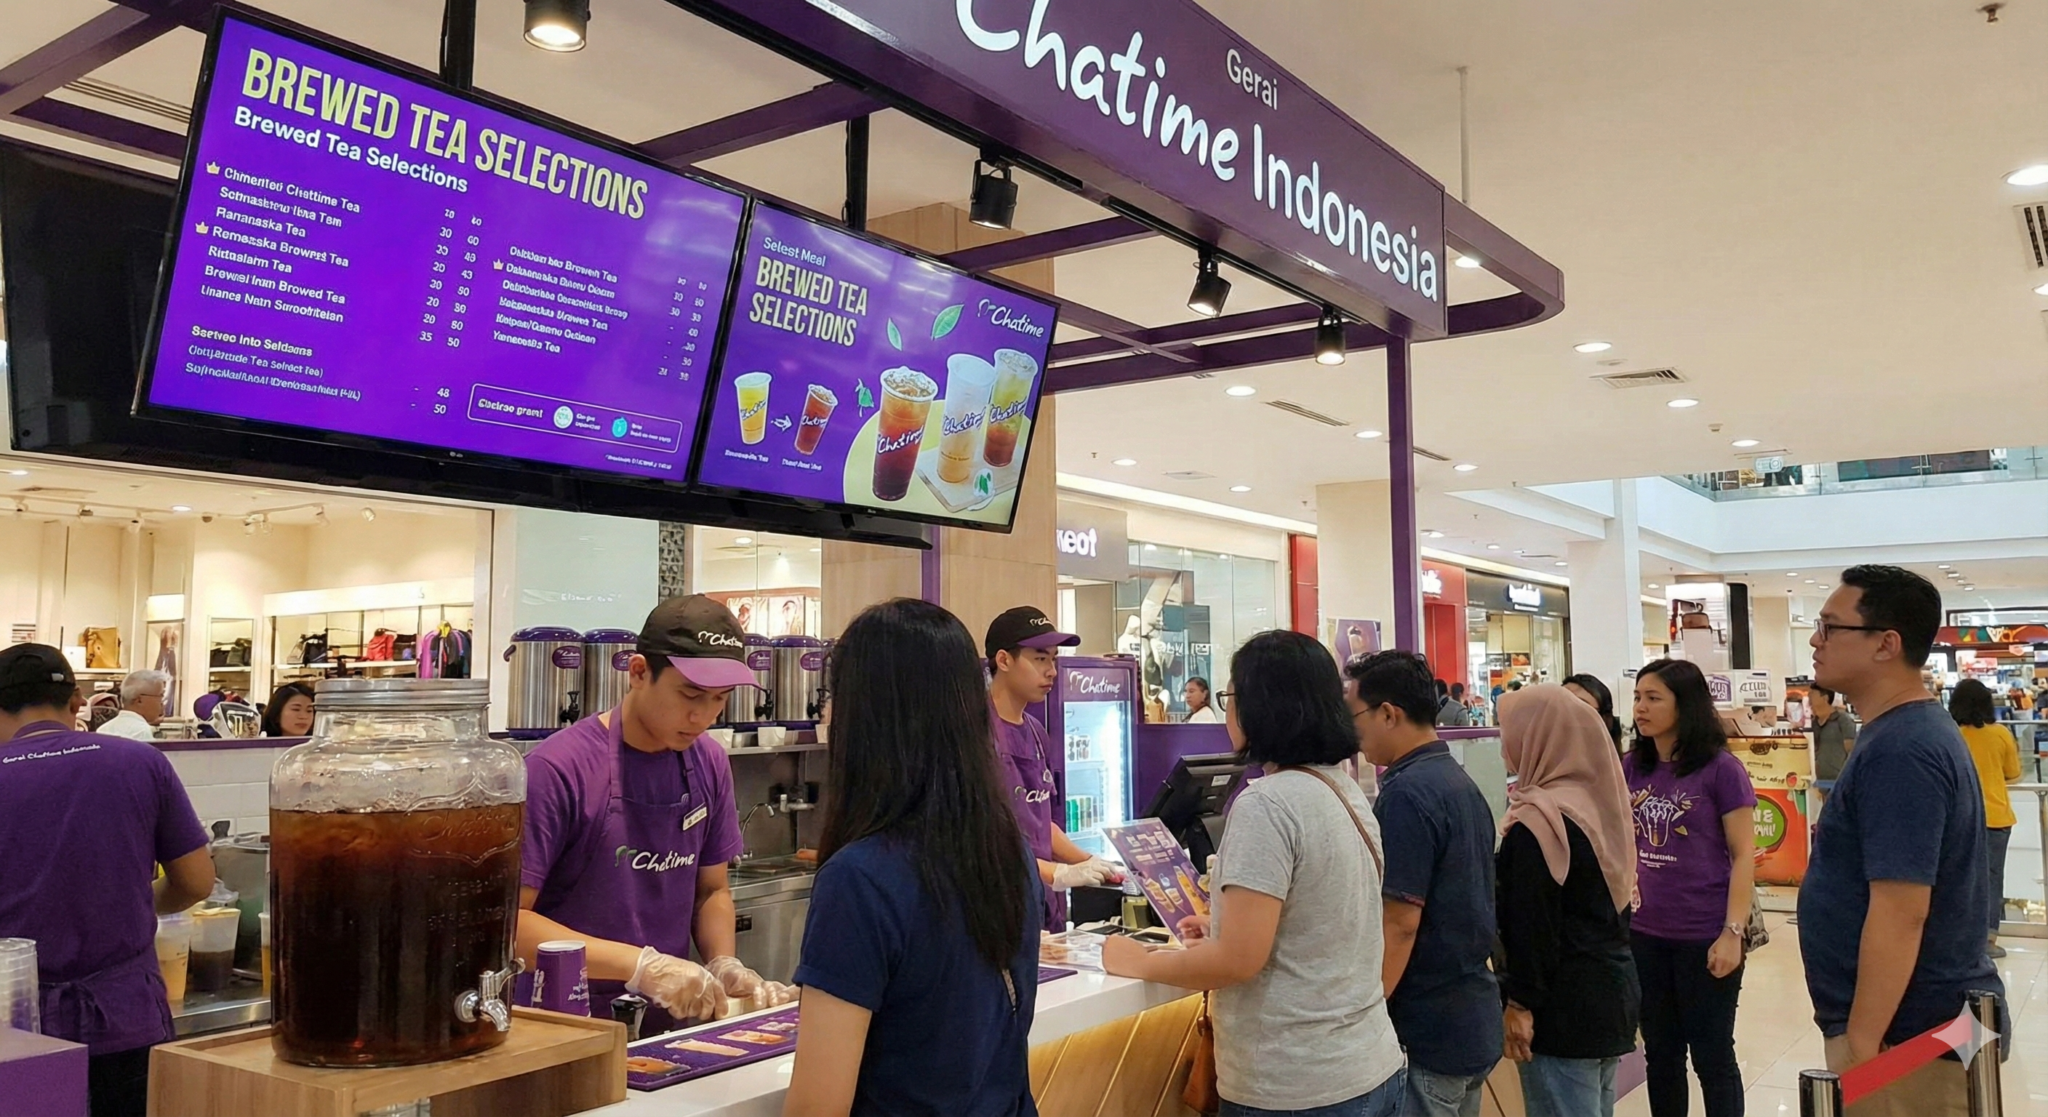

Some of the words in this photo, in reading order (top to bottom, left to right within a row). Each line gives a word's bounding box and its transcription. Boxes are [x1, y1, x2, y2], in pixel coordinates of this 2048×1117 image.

[1226, 47, 1279, 111] Gerai
[242, 48, 400, 140] BREWED
[409, 103, 467, 164] TEA
[474, 128, 649, 219] SELECTIONS
[234, 105, 321, 149] Brewed
[326, 133, 361, 161] Tea
[366, 147, 469, 193] Selections
[955, 0, 1240, 181] Chatime
[1253, 123, 1438, 302] Indonesia
[341, 197, 360, 214] Tea
[286, 223, 306, 238] Tea
[439, 227, 452, 239] 30
[329, 253, 350, 267] Tea
[801, 248, 827, 267] Meal
[271, 259, 293, 274] Tea
[756, 255, 834, 305] BREWED
[837, 280, 868, 316] TEA
[326, 291, 346, 305] Tea
[422, 313, 436, 324] 20
[749, 292, 857, 347] SELECTIONS
[991, 306, 1044, 338] Chatime
[419, 331, 433, 342] 35
[447, 337, 460, 348] 50
[437, 388, 450, 398] 48
[433, 404, 447, 414] 50
